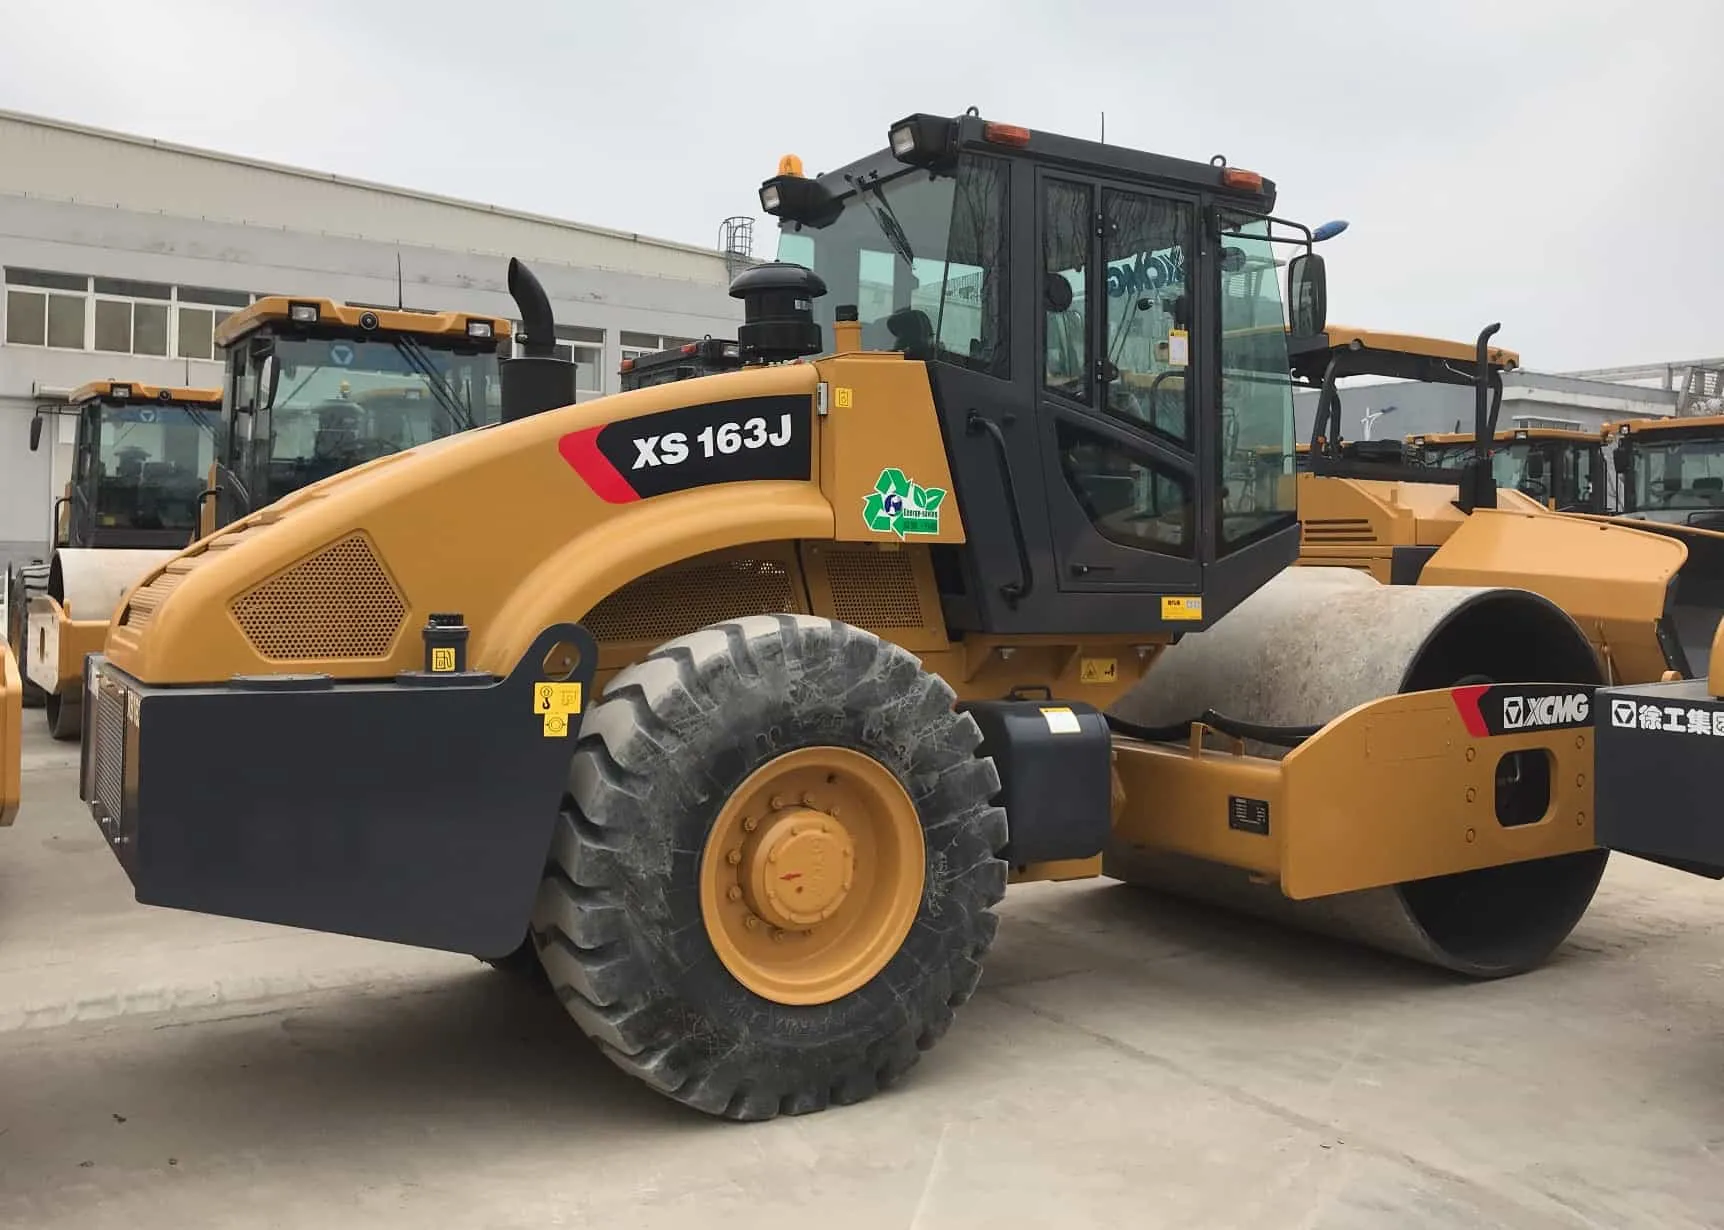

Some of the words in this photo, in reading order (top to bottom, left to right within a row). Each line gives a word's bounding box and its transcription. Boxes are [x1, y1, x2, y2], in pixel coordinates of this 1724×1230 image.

[632, 432, 689, 470] XS
[697, 413, 792, 458] 163J
[1523, 693, 1589, 727] XCMG
